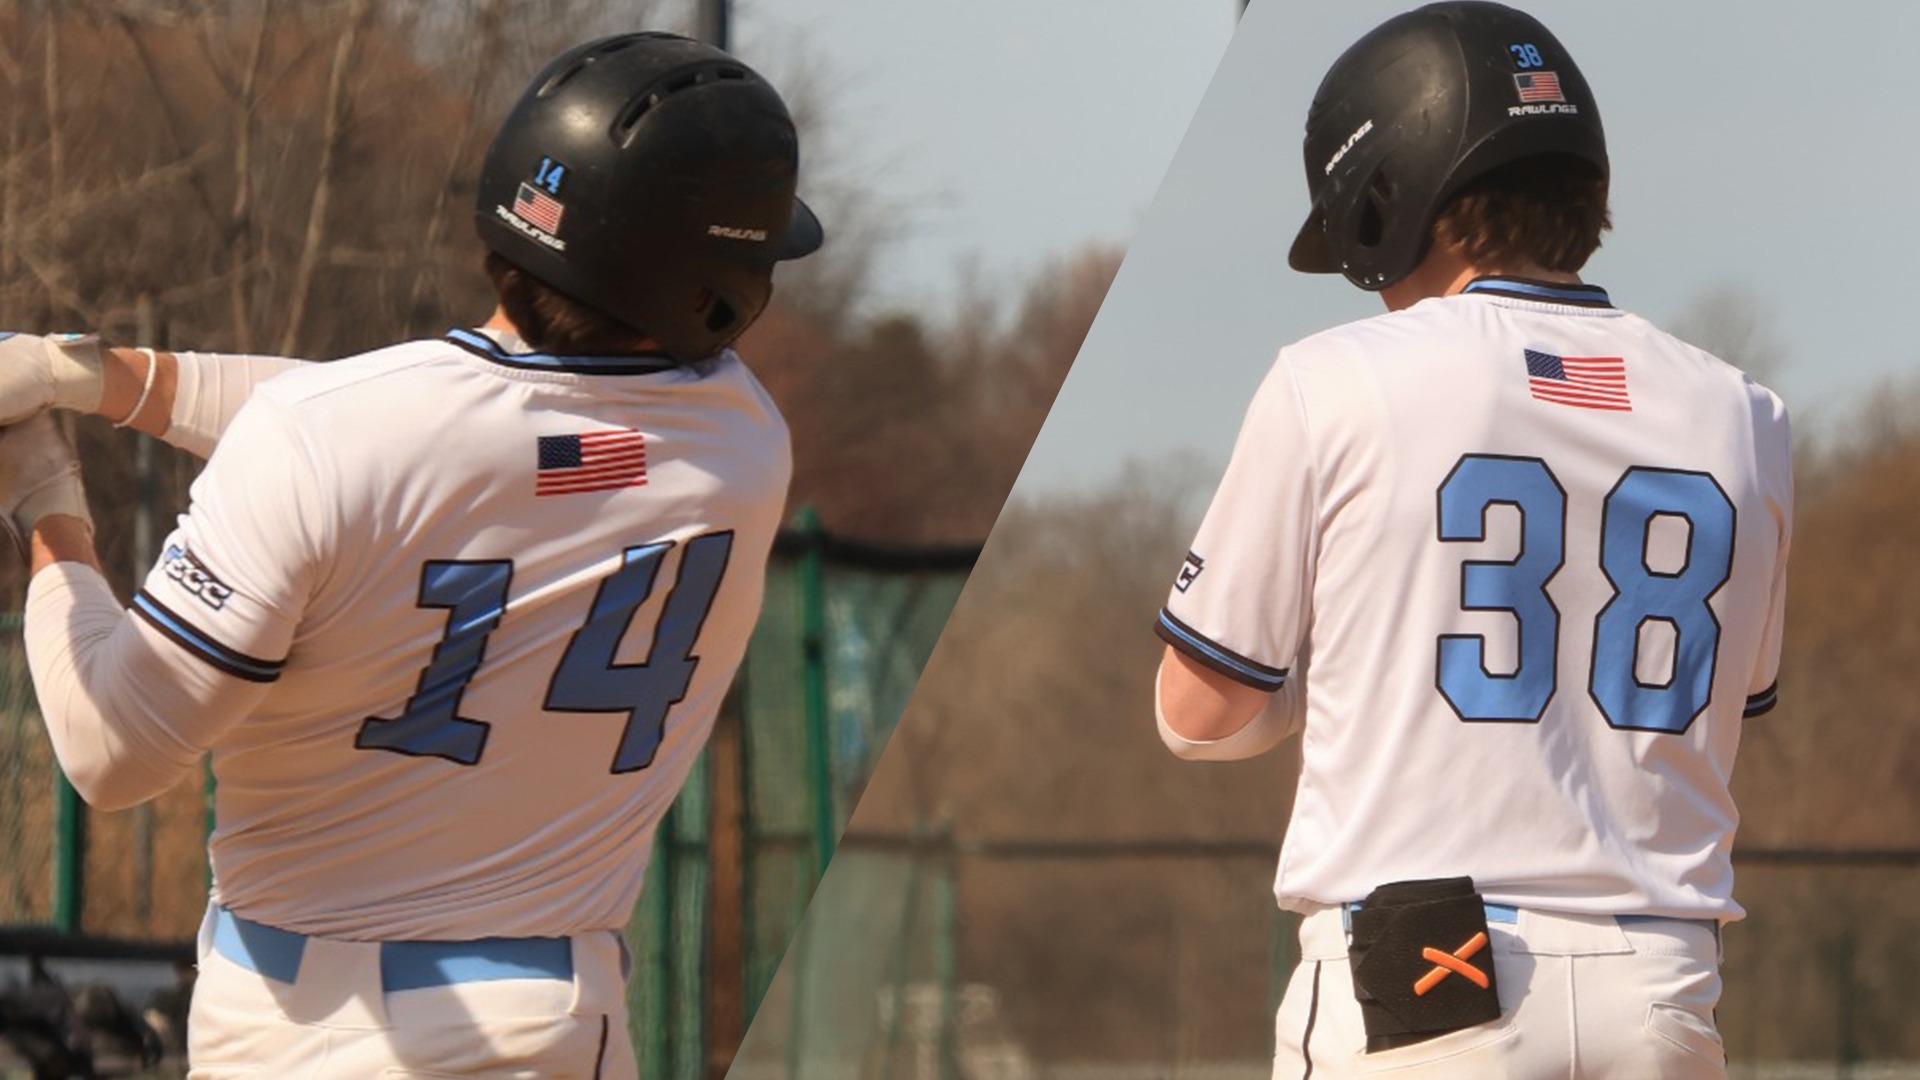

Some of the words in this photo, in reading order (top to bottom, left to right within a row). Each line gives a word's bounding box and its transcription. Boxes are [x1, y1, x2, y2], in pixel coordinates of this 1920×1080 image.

[1510, 43, 1543, 68] 38
[1507, 103, 1578, 117] RAWLINGS
[534, 157, 565, 194] 14
[1434, 453, 1738, 736] 38
[354, 529, 735, 775] 14
